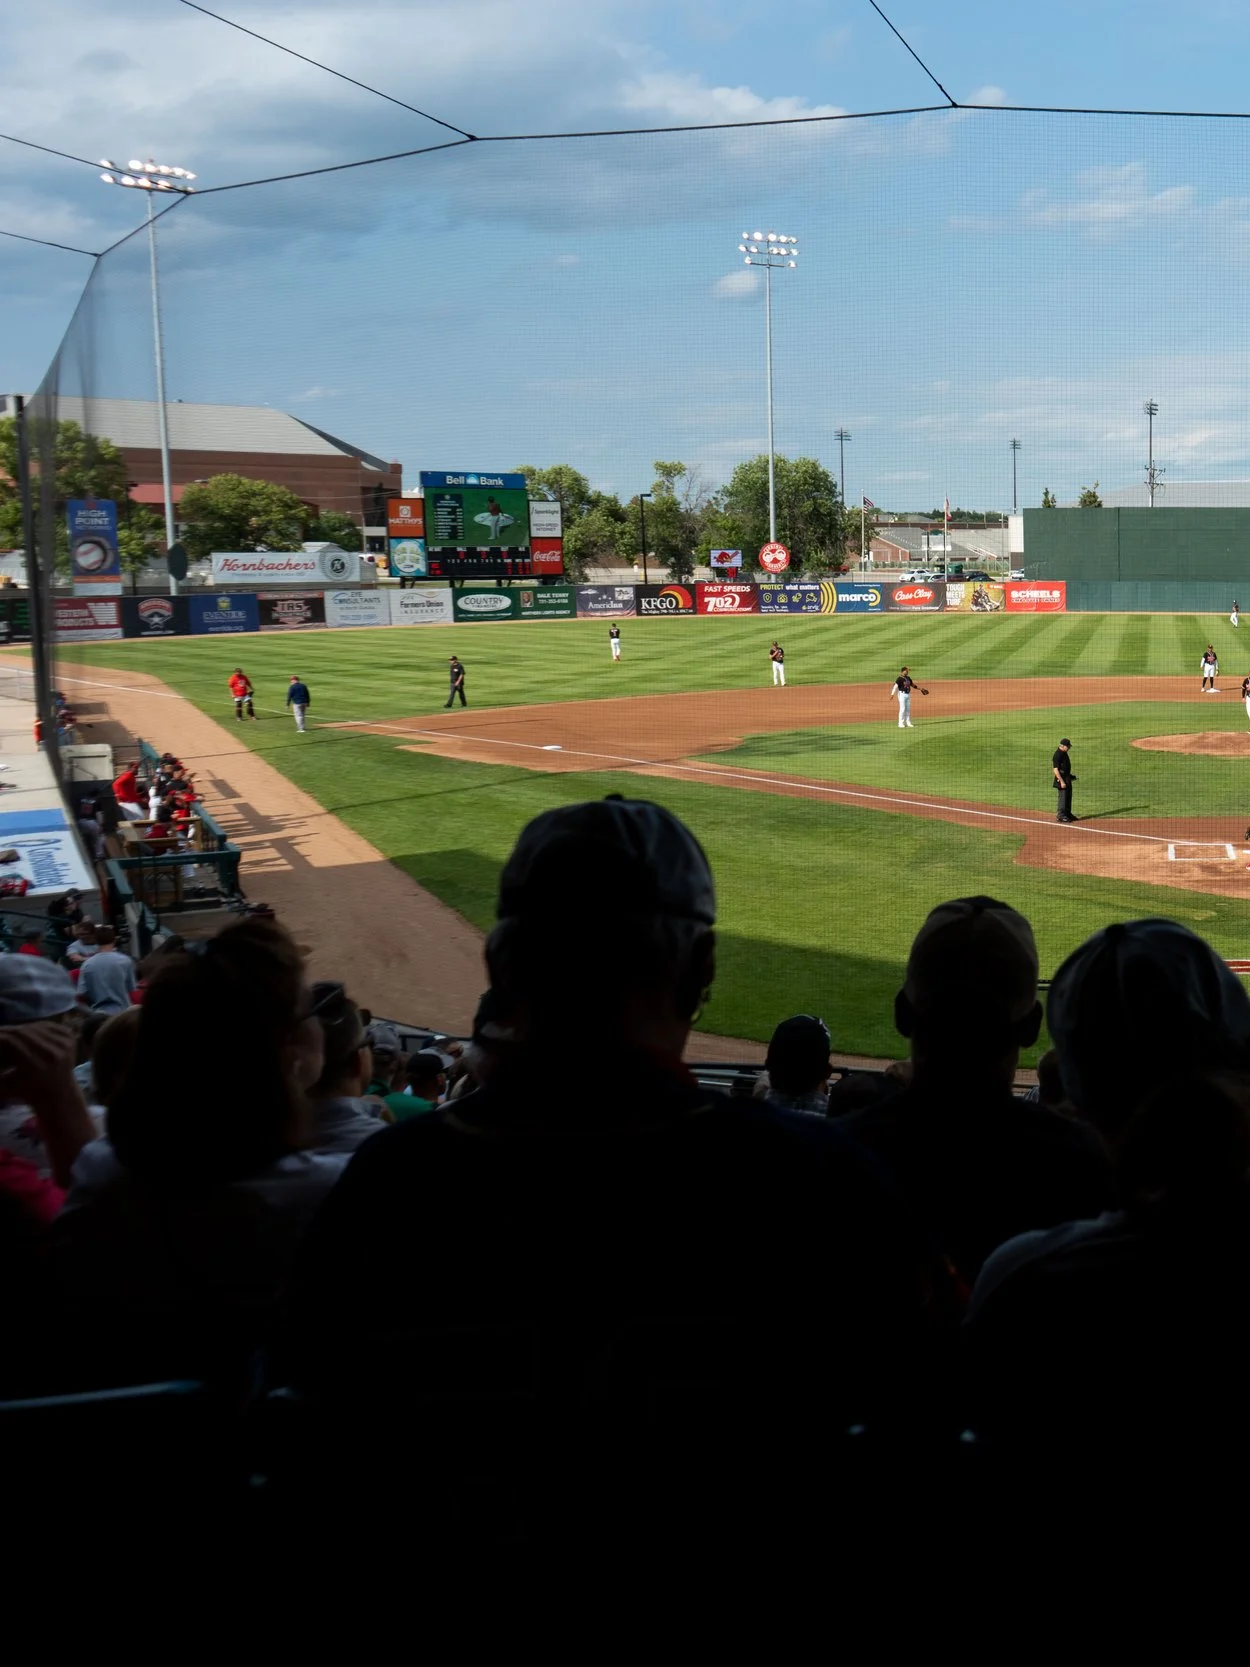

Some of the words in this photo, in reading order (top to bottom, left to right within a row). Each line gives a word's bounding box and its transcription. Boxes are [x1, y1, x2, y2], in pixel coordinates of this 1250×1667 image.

[446, 475, 465, 485] Bell
[480, 476, 504, 486] Bank
[839, 593, 876, 602] marco
[1011, 590, 1060, 598] SCHEELS
[400, 601, 426, 609] Farmers
[426, 600, 444, 608] Union
[463, 597, 502, 605] COUNTRY
[641, 598, 676, 609] KFGO
[704, 597, 734, 612] 702
